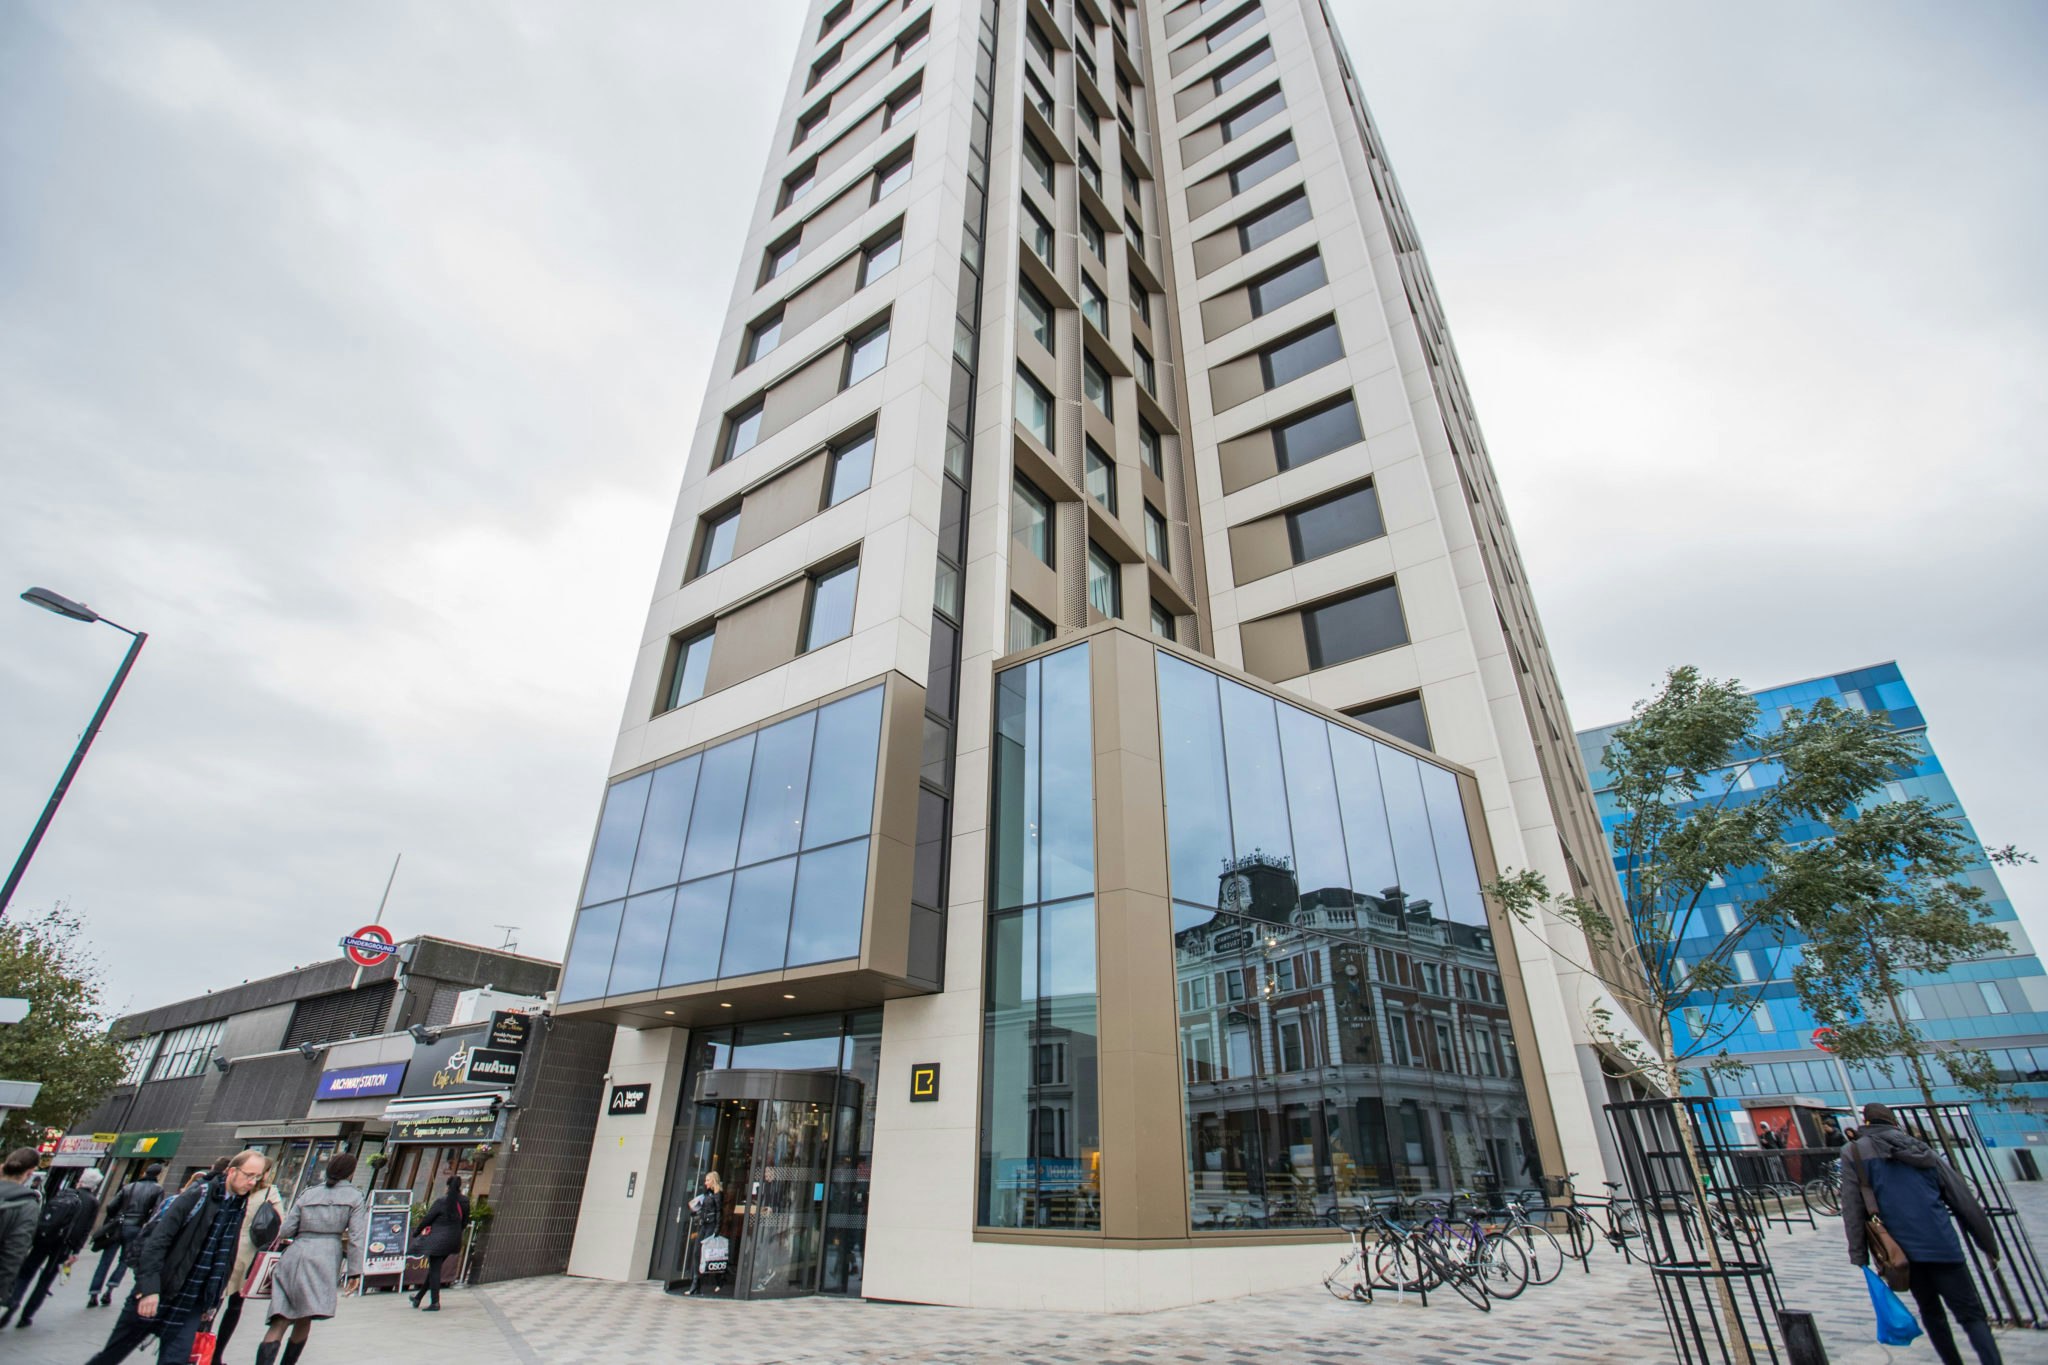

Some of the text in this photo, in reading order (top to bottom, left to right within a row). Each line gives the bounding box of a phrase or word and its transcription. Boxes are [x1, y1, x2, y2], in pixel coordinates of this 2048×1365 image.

[346, 938, 395, 952] UNDERGROUND
[472, 1060, 515, 1075] LAVAZZA
[330, 1074, 388, 1091] ARCHWAY STATION
